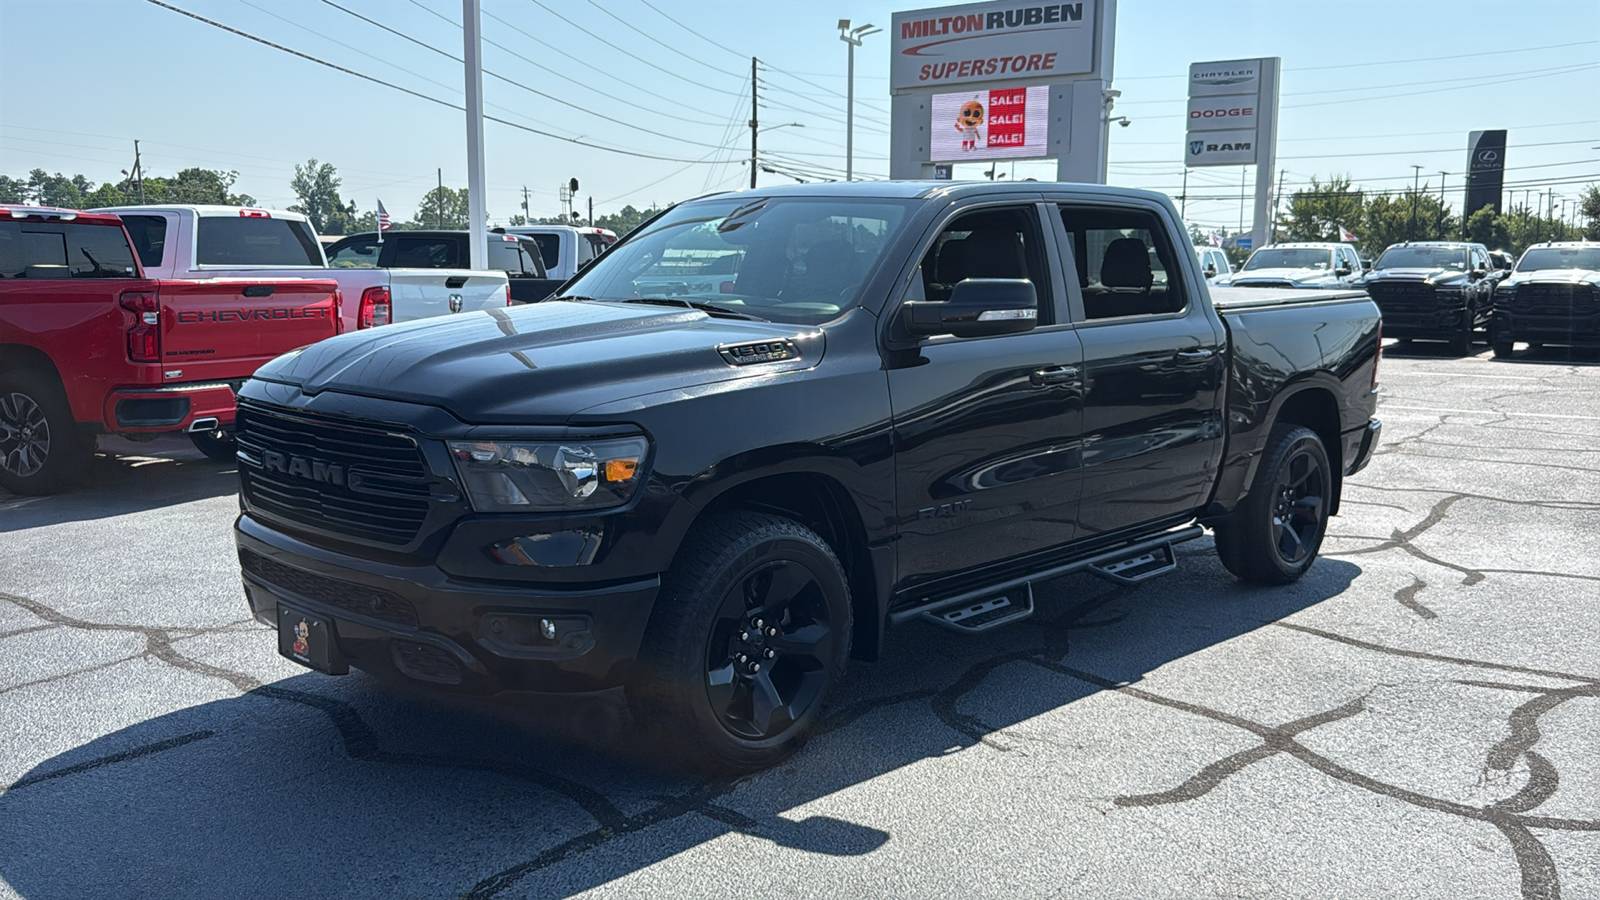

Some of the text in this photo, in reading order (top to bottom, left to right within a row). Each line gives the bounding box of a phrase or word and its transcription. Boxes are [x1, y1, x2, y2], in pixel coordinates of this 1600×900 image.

[918, 52, 1058, 81] SUPERSTORE
[1193, 70, 1253, 78] CHRYSLER
[990, 95, 1025, 106] SALE!
[1190, 108, 1253, 119] DODGE
[989, 114, 1024, 125] SALE!
[988, 133, 1024, 144] SALE!
[1206, 142, 1251, 152] RAM
[177, 307, 330, 324] CHEVROLET
[732, 342, 785, 357] 1500
[264, 450, 344, 486] RAM
